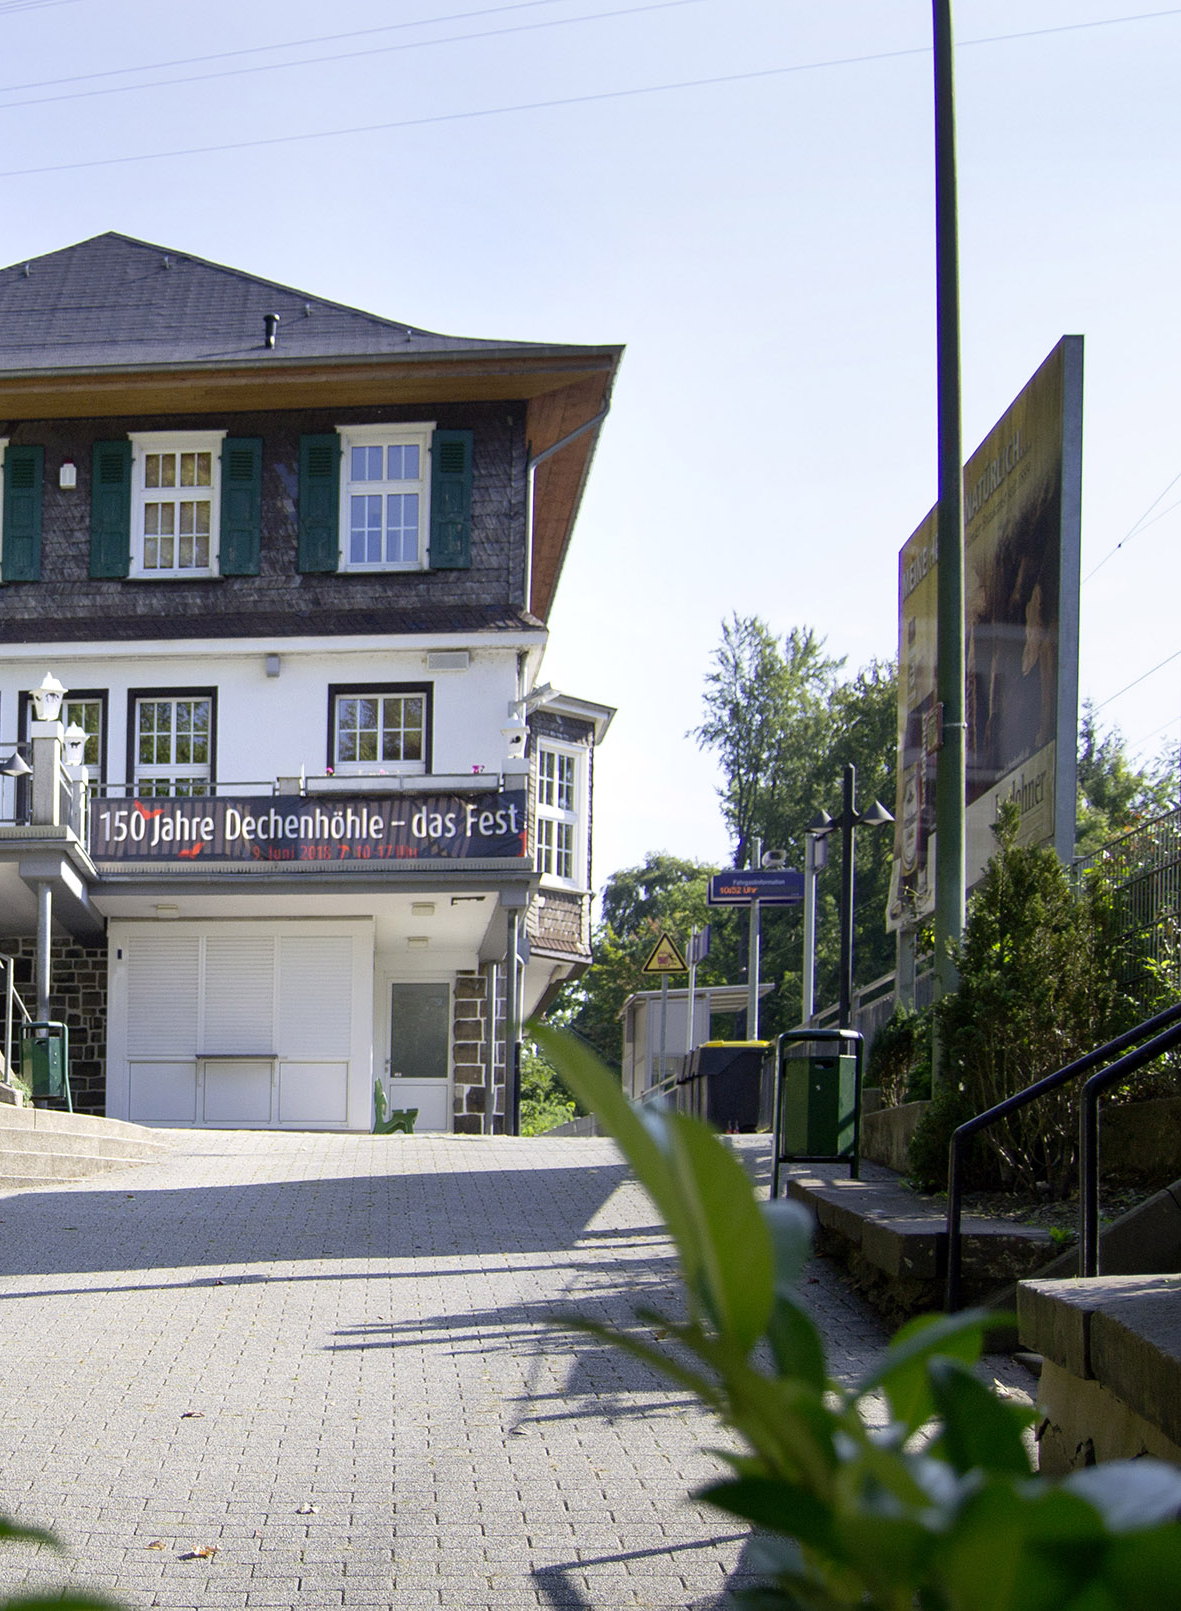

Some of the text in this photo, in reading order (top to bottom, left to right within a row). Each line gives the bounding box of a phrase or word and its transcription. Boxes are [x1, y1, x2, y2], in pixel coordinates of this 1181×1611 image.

[100, 810, 146, 841] 150
[150, 810, 214, 847] Jahre
[225, 808, 384, 841] Dechenhöhle
[412, 805, 456, 838] das
[465, 803, 519, 837] Fest
[252, 845, 264, 860] 9.
[269, 845, 295, 860] Juni
[300, 845, 332, 860] 2018
[396, 844, 418, 859] Uhr
